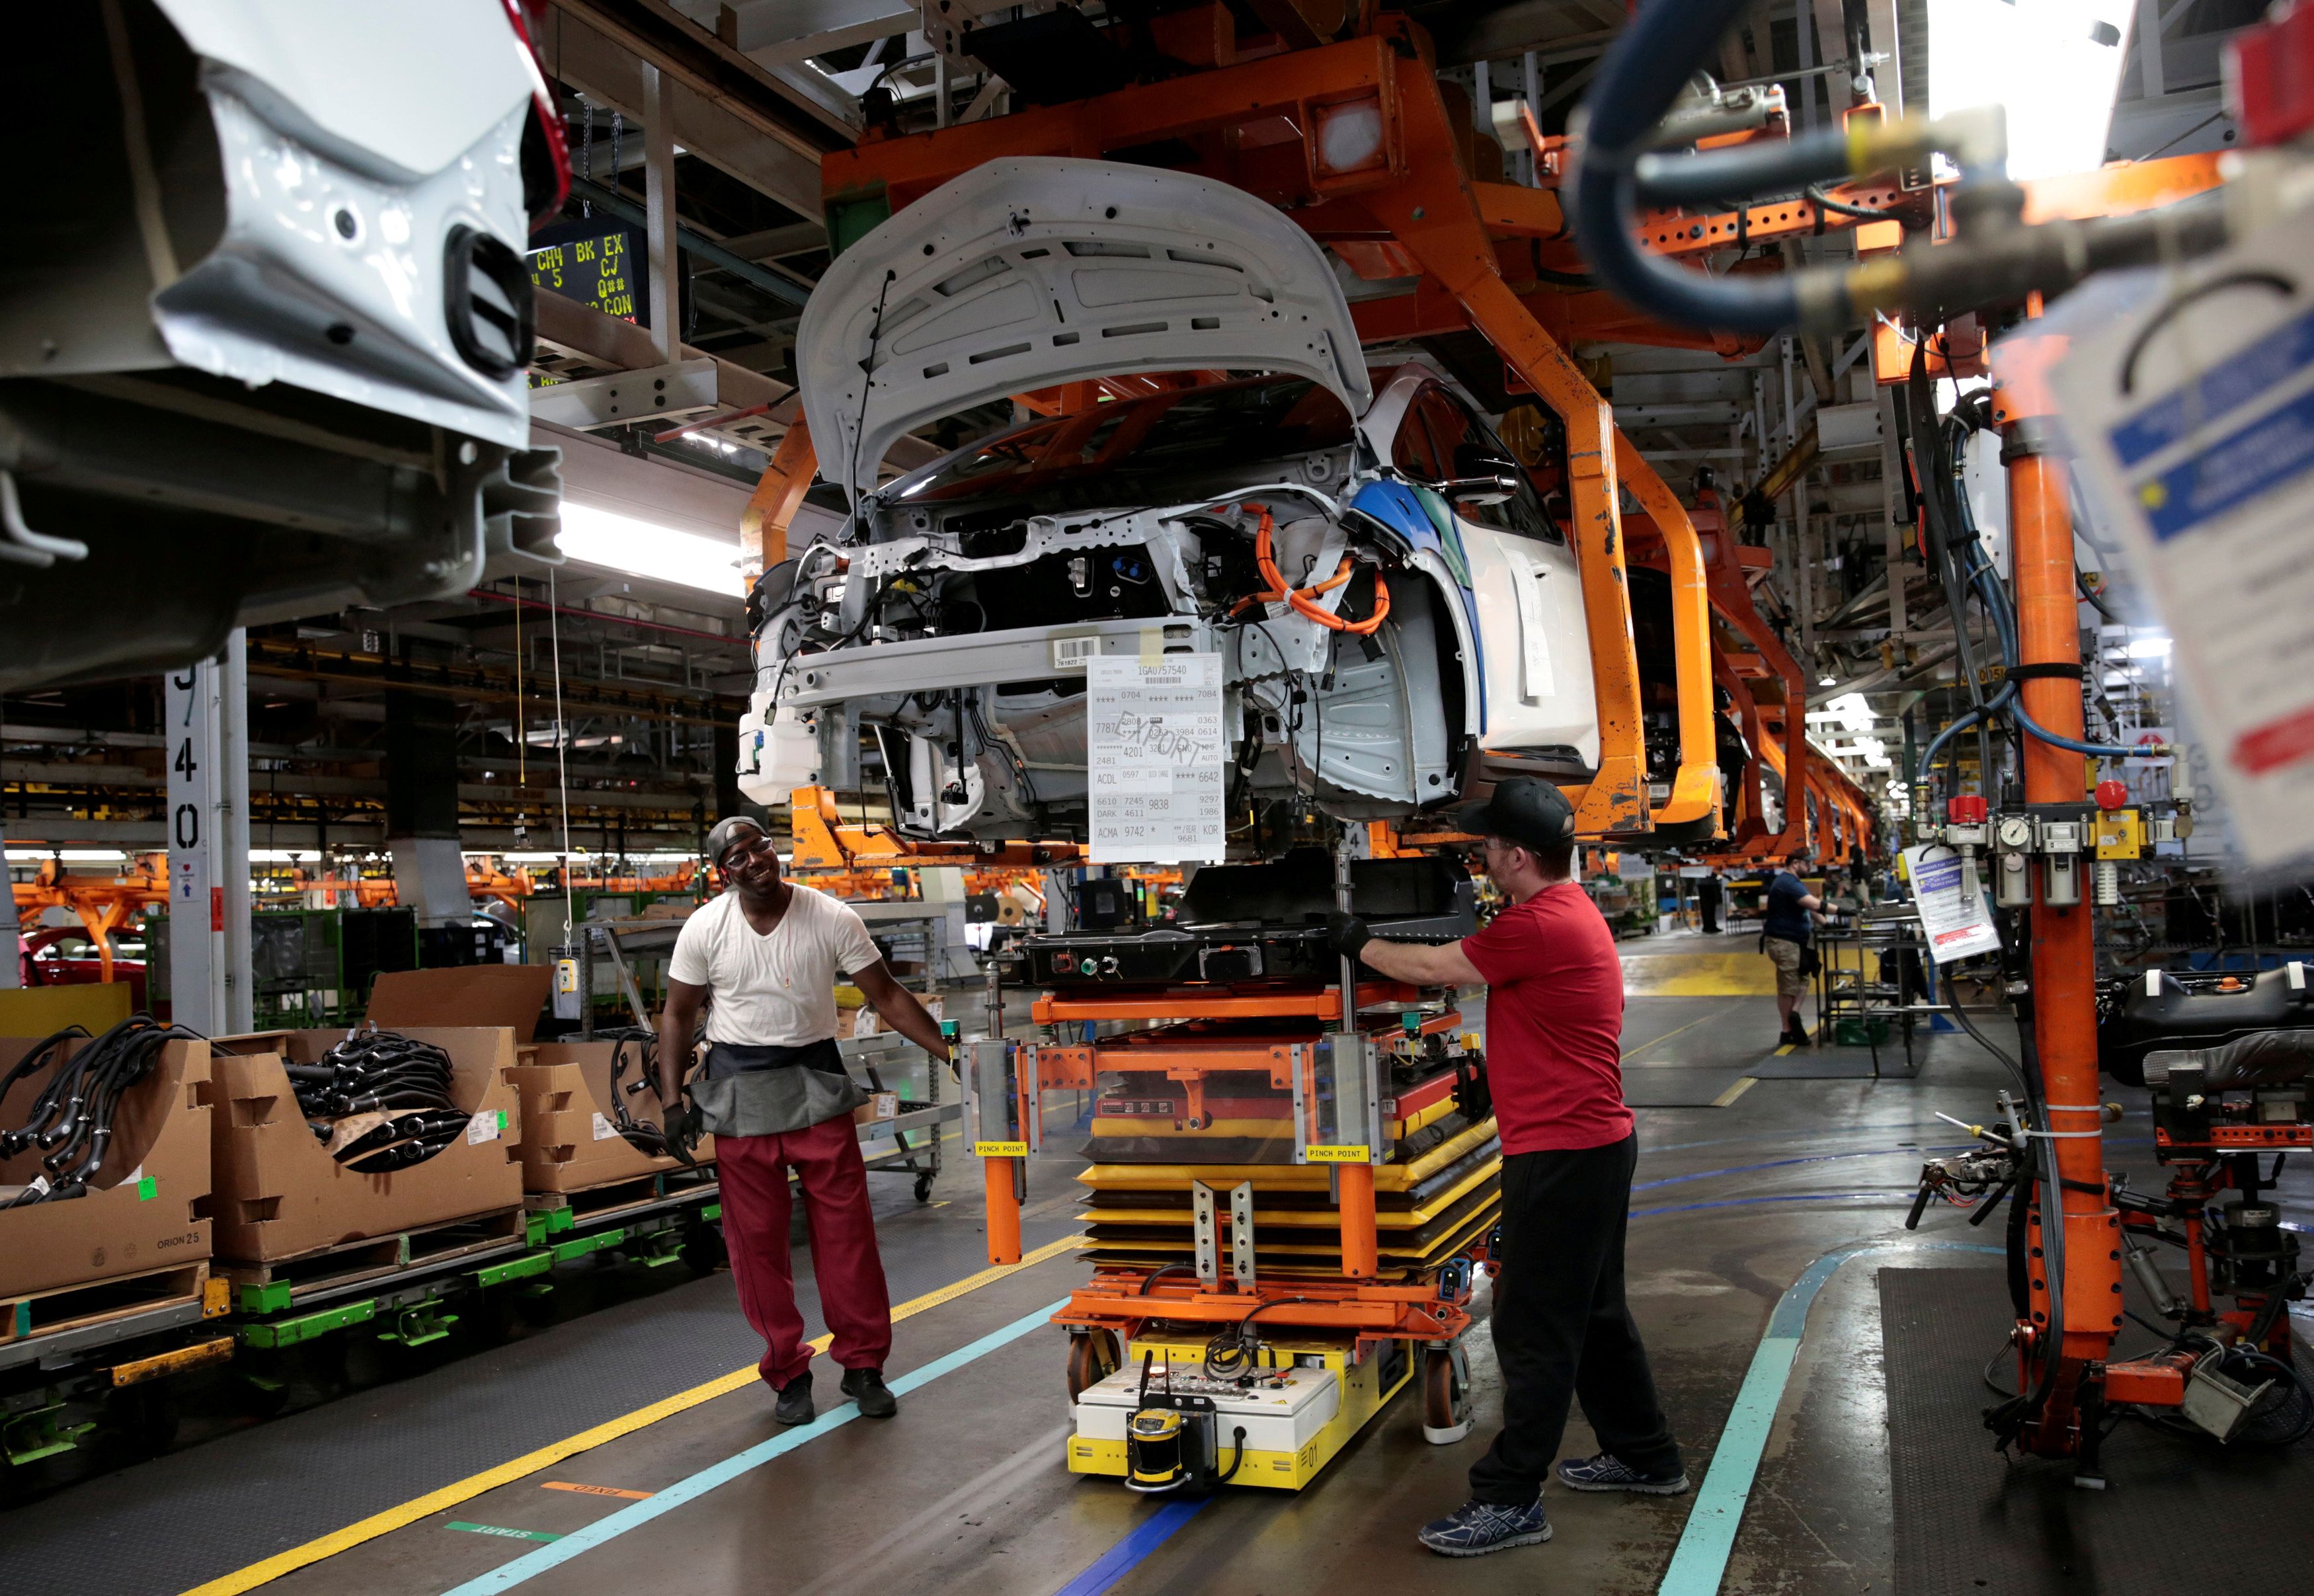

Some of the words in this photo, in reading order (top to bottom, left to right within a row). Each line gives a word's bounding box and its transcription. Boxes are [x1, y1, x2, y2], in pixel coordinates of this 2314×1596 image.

[575, 240, 594, 262] BK
[604, 234, 623, 256] EX
[1096, 723, 1115, 733] 7787
[1114, 710, 1204, 767] EXPORT
[1124, 747, 1143, 757] 4201
[1097, 774, 1117, 784] ACDL
[1199, 772, 1218, 782] 6642
[1149, 799, 1169, 810] 9838
[1097, 828, 1118, 838] ACMA
[1125, 826, 1144, 837] 9742
[1203, 824, 1218, 835] KOR
[157, 1236, 184, 1249] ORION
[186, 1232, 199, 1244] 25
[574, 1485, 623, 1495] FIXED
[471, 1525, 533, 1538] START
